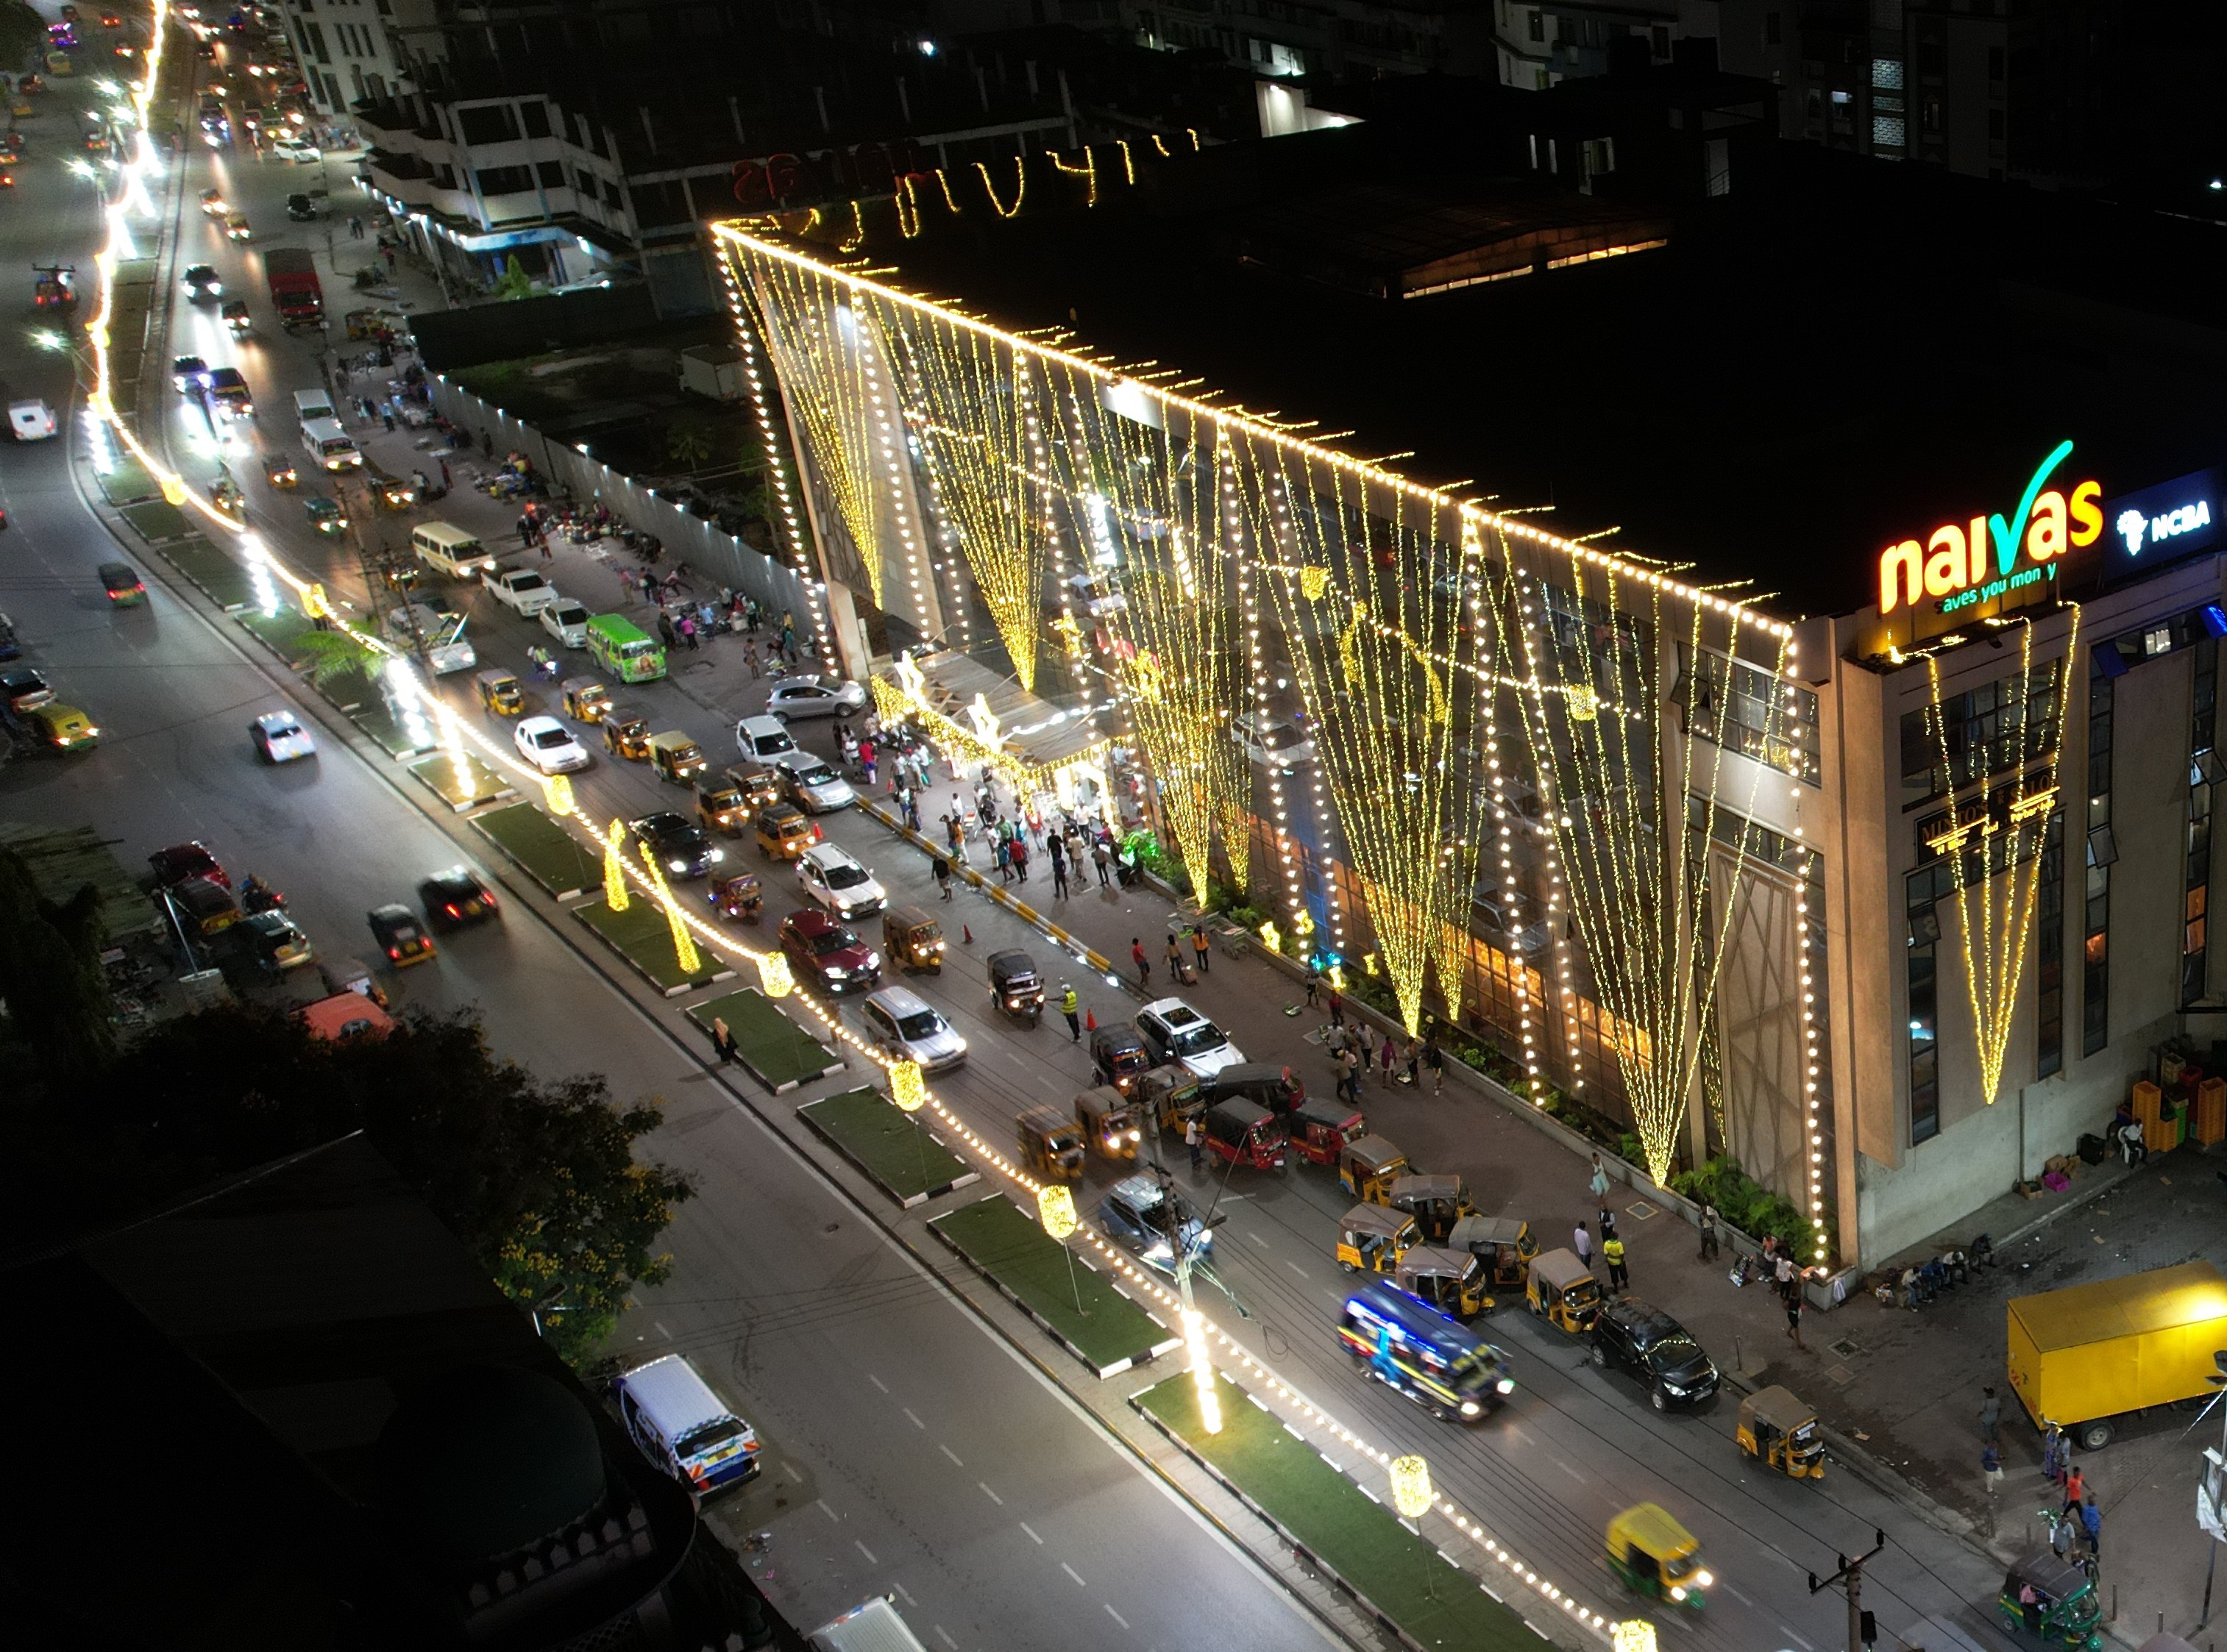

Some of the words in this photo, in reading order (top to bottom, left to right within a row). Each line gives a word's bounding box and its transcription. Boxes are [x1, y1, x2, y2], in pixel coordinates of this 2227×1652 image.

[1880, 440, 2103, 615] naivas
[2151, 501, 2211, 543] NCBA
[1980, 579, 2007, 603] you
[2009, 562, 2057, 589] mony
